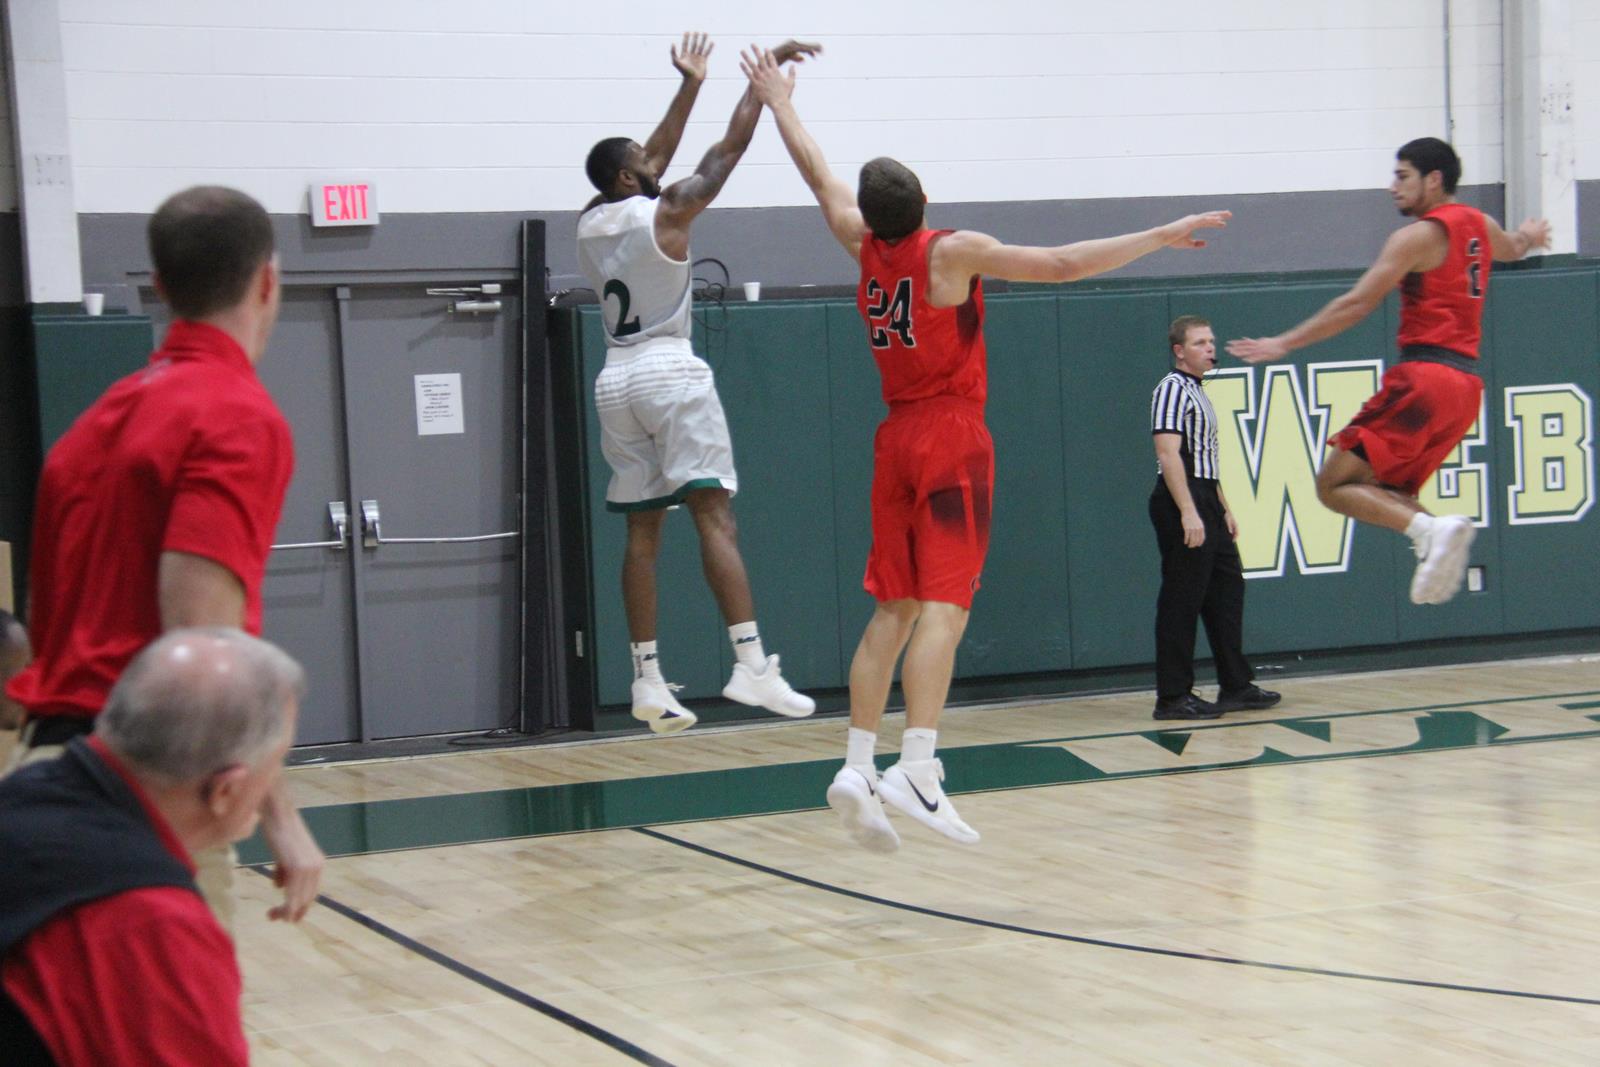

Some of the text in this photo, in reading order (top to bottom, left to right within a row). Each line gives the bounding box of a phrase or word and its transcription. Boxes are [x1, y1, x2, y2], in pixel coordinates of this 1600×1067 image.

[323, 184, 369, 221] EXIT
[603, 278, 641, 338] 2
[867, 277, 917, 349] 24
